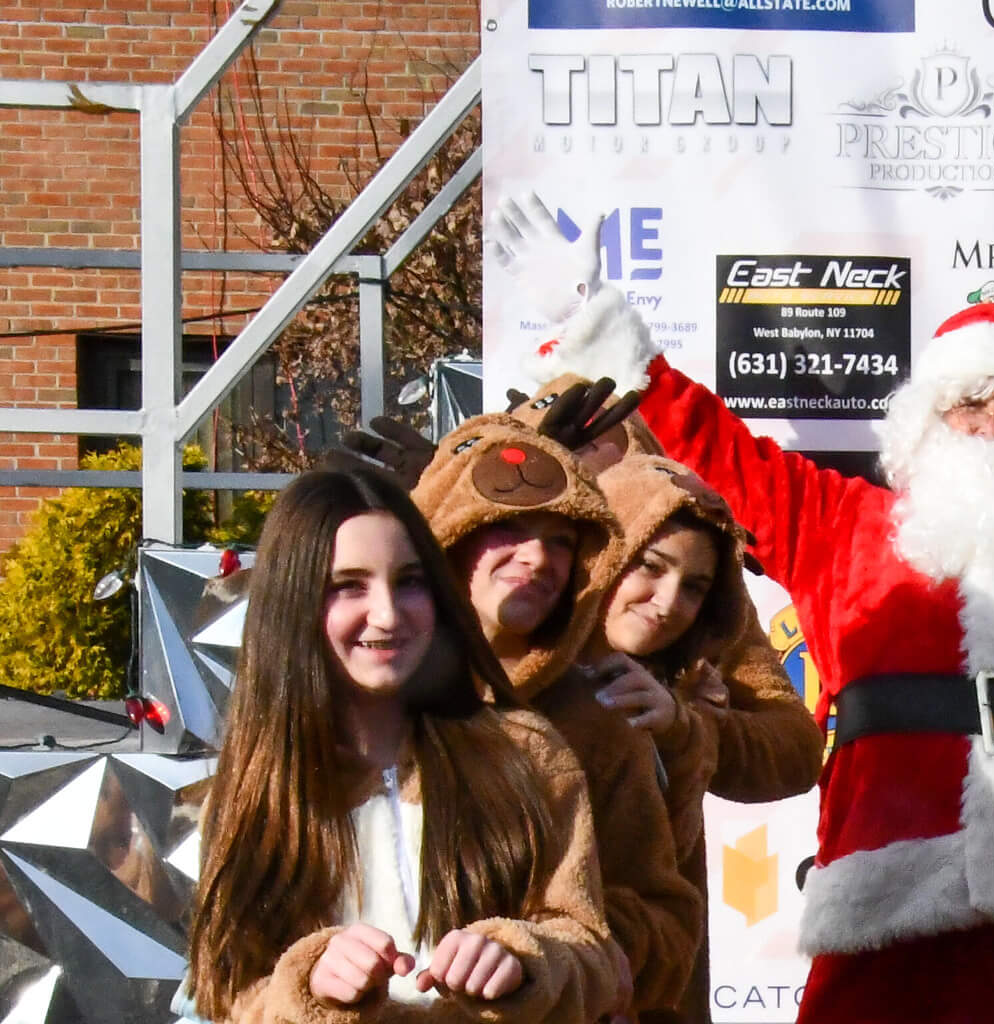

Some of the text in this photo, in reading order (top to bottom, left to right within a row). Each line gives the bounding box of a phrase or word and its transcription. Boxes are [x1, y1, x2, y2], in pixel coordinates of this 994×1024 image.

[528, 53, 793, 126] TITAN
[727, 260, 907, 289] East Neck
[626, 291, 663, 311] Envy
[780, 307, 847, 318] 89 Route 109
[753, 327, 875, 340] West Babylon, NY 11704
[729, 351, 899, 379] (631) 321-7434
[724, 395, 890, 410] www.eastneckauto.co
